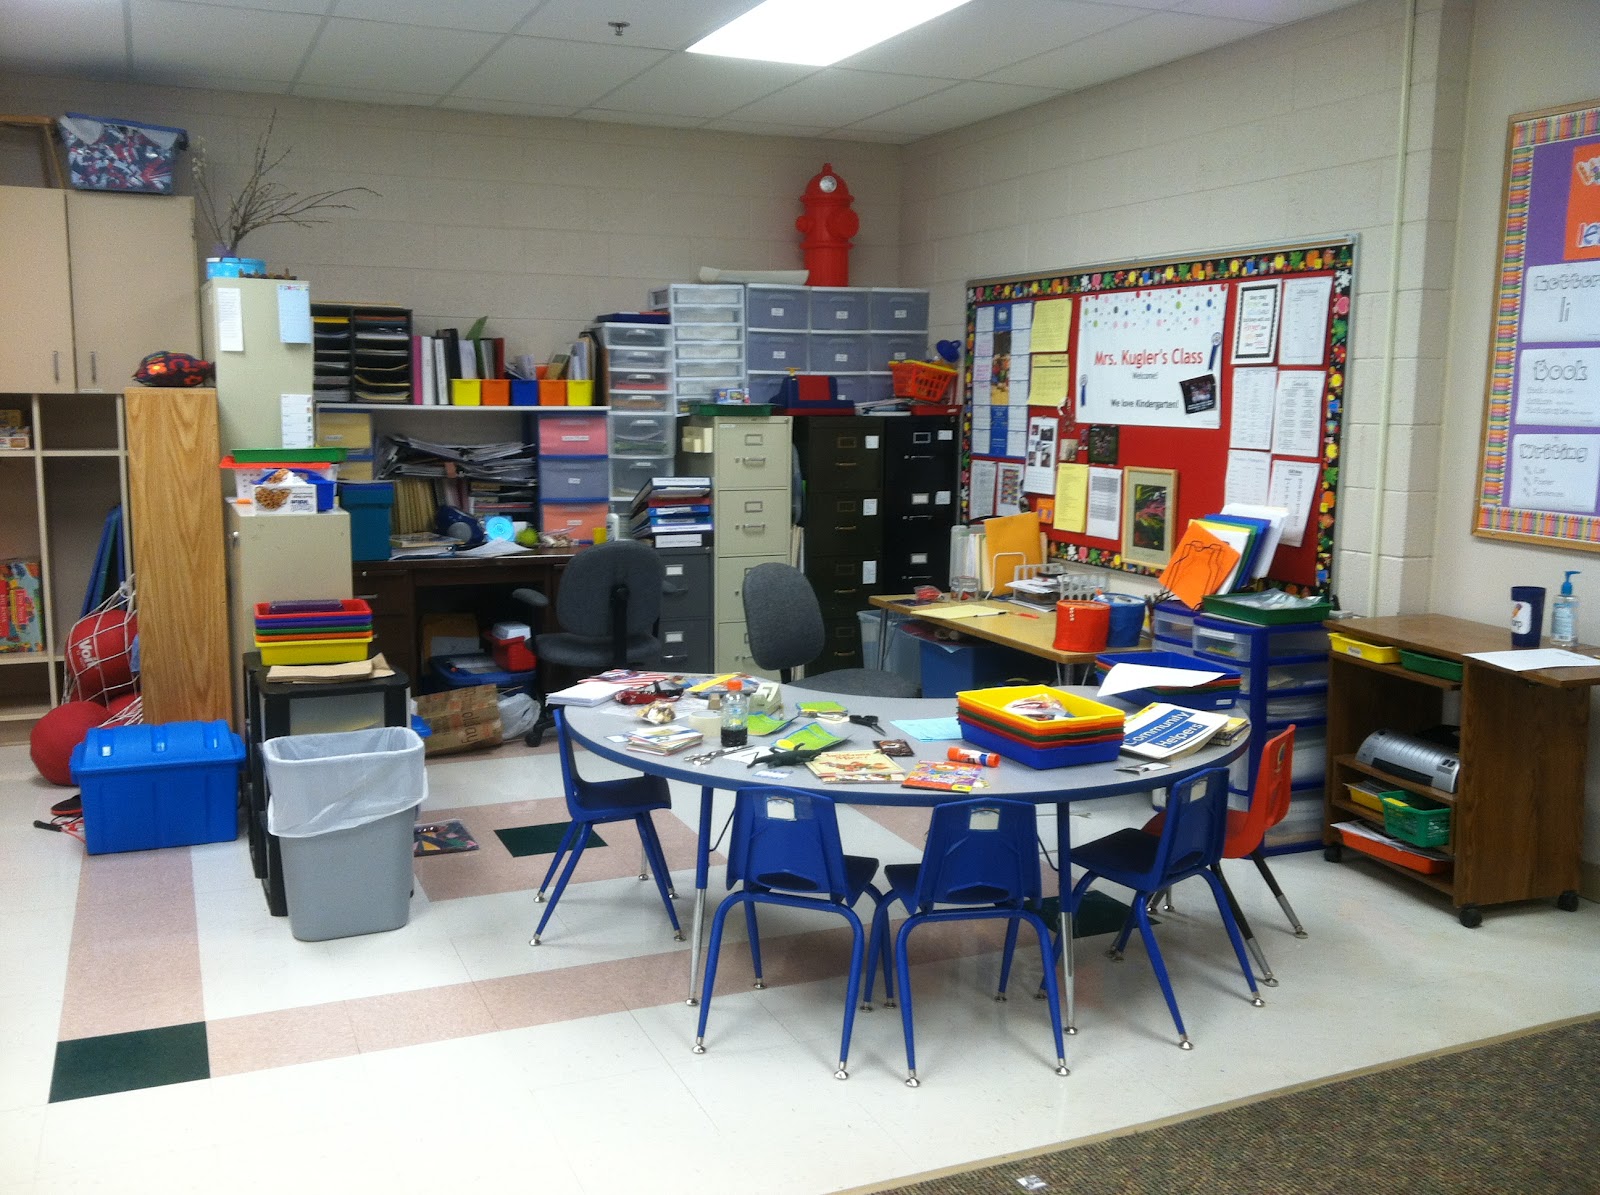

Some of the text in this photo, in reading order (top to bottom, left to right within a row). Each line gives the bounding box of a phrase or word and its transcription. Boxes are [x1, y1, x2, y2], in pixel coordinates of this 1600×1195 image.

[1094, 347, 1203, 368] Mrs. Kugler's Class
[1533, 359, 1588, 381] Book
[1111, 399, 1121, 407] We
[1122, 400, 1134, 408] love
[1519, 443, 1589, 462] Writing
[1123, 711, 1190, 745] Community
[1156, 723, 1204, 747] Helpers
